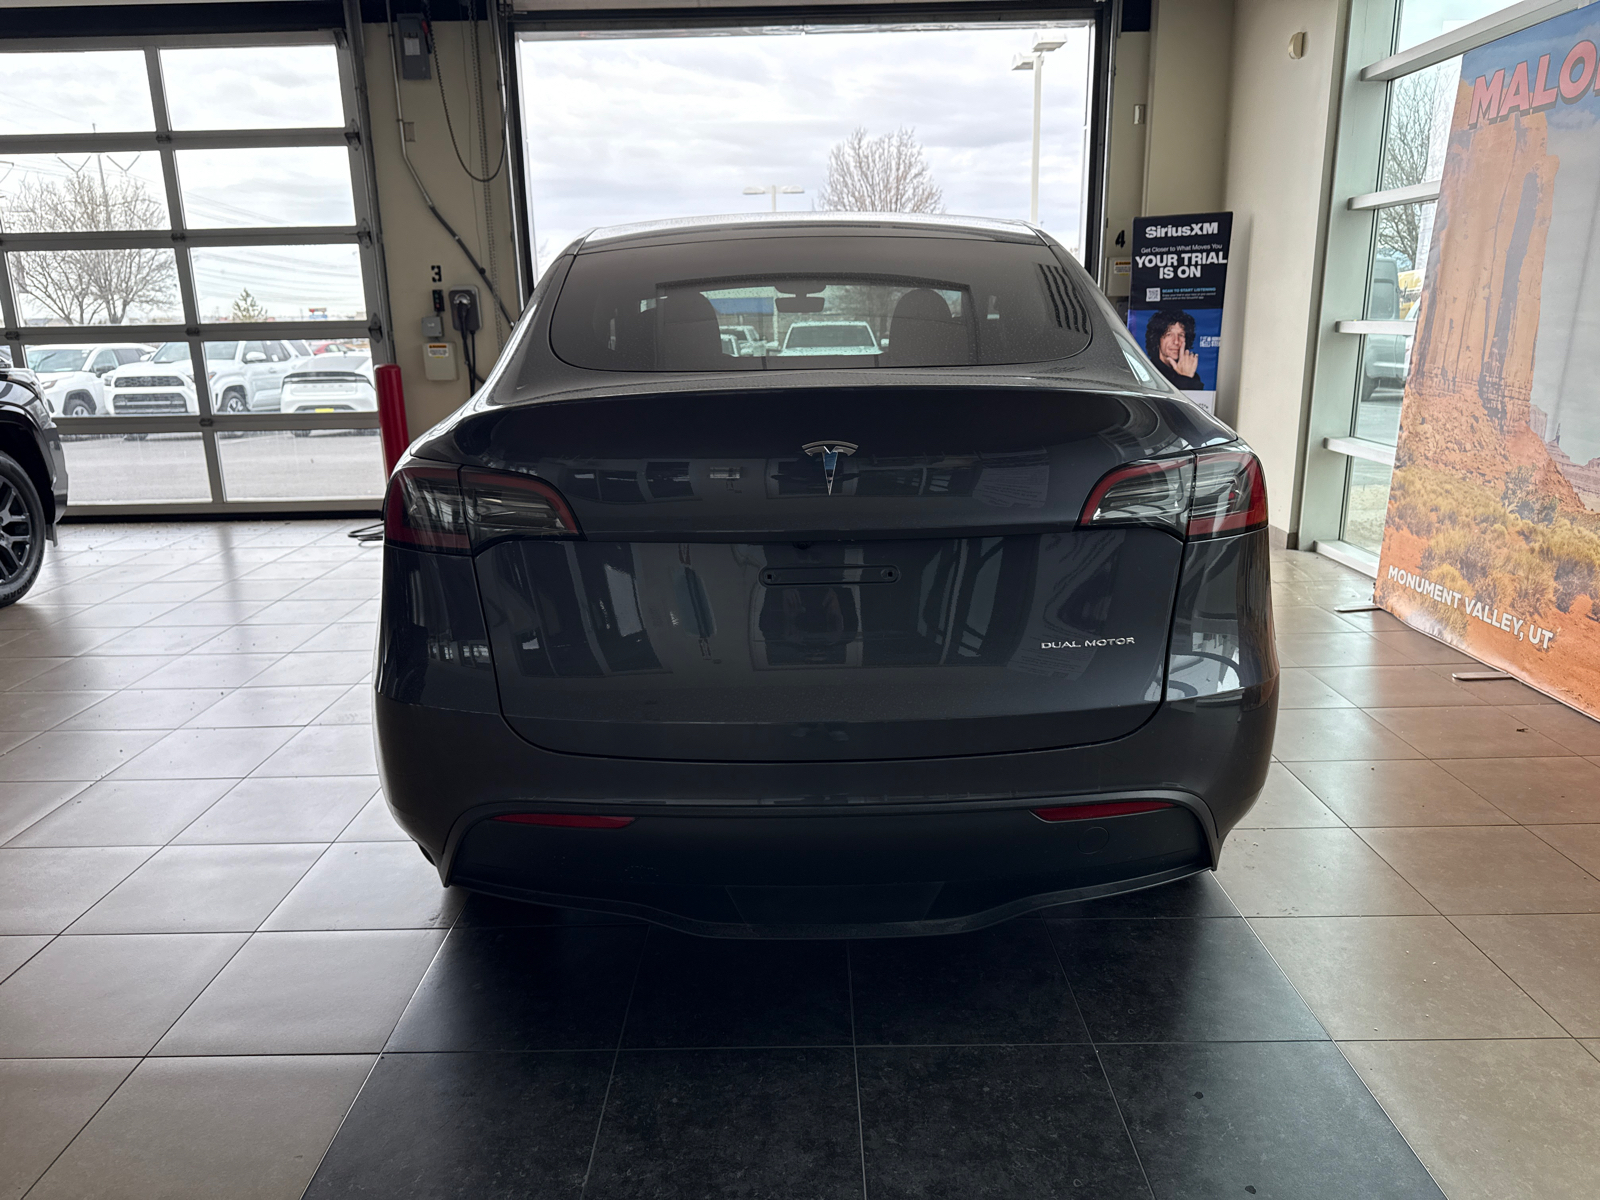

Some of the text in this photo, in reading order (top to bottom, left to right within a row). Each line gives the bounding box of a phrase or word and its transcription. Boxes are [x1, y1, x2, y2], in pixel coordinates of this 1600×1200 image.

[1468, 39, 1600, 130] MALO
[1145, 222, 1218, 238] SiriusXM
[1115, 230, 1125, 248] 4
[1135, 254, 1178, 268] YOUR
[1181, 251, 1228, 265] TRIAL
[431, 265, 442, 282] 3
[1159, 265, 1201, 279] IS ON
[1388, 565, 1554, 649] MONUMENT VALLEY, UT
[1041, 637, 1135, 649] DUAL MOTOR
